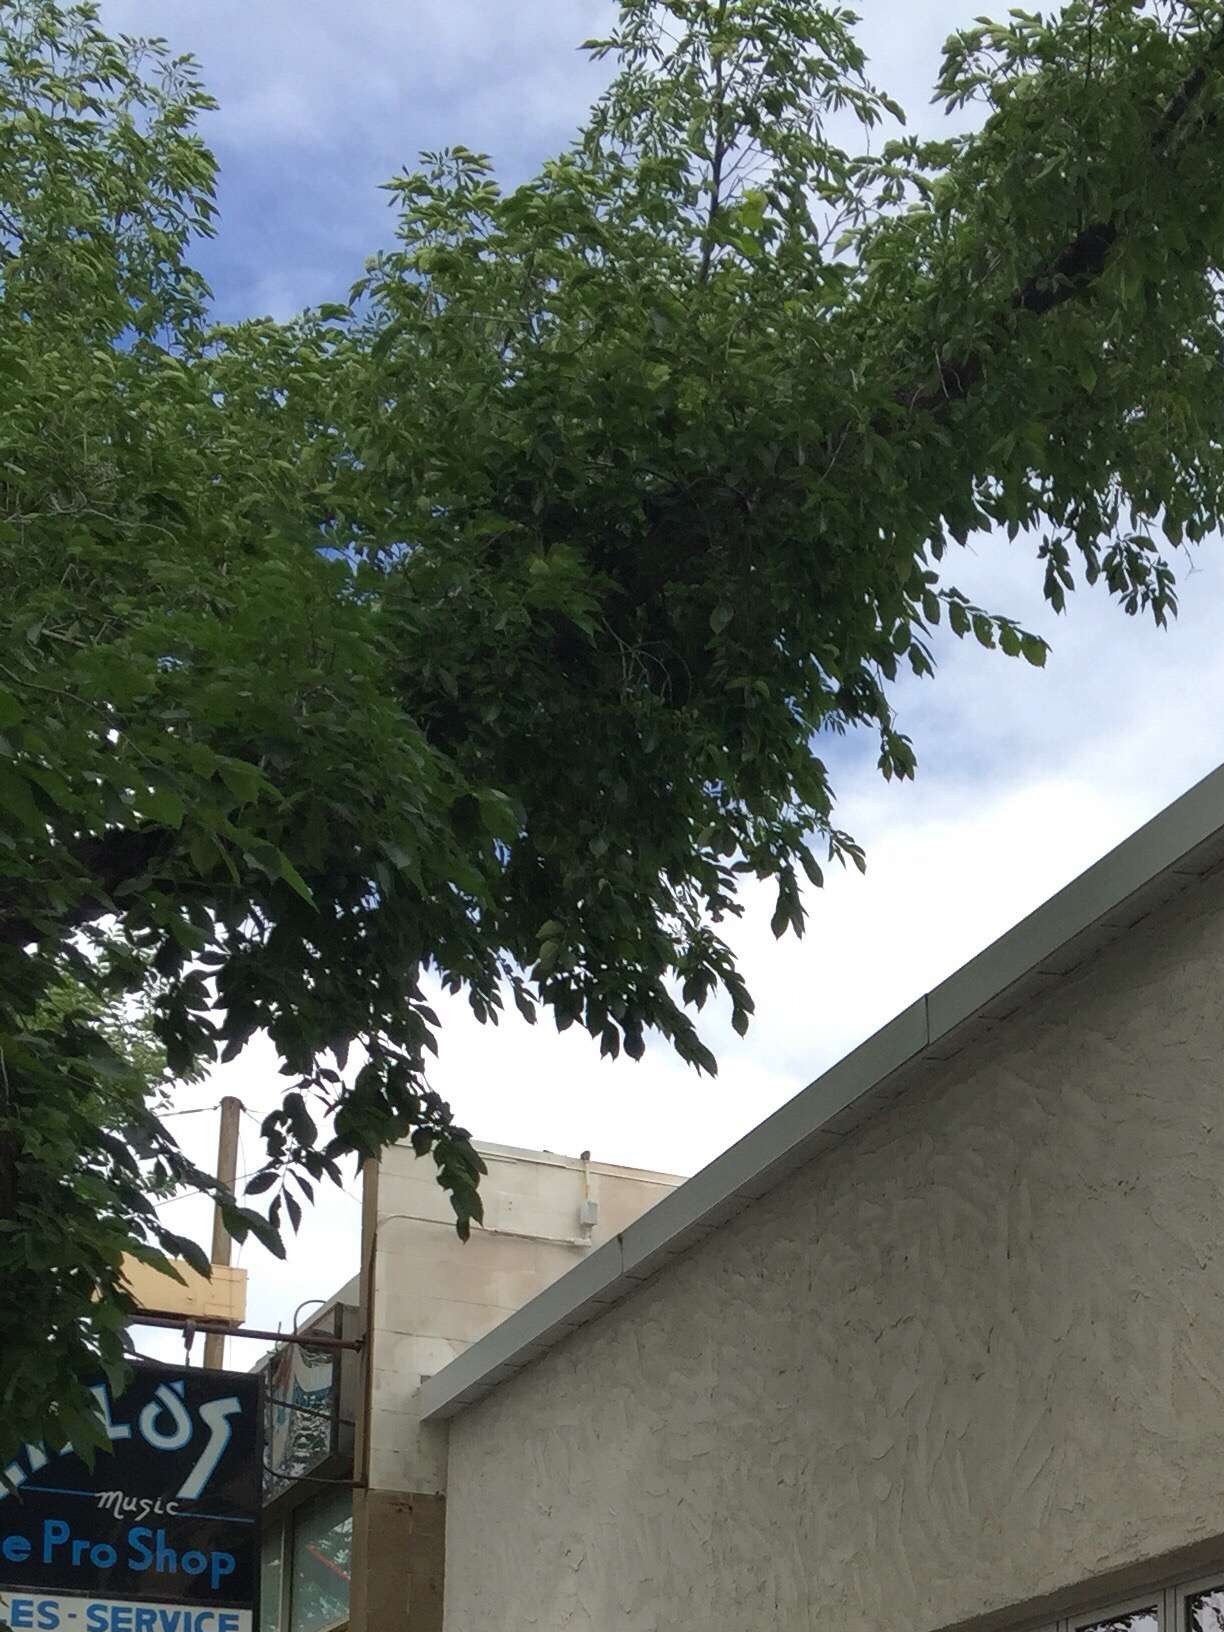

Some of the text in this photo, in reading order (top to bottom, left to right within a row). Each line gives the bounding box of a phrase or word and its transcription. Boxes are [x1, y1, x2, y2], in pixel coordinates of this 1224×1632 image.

[95, 1490, 180, 1521] Music
[43, 1519, 118, 1569] Pro
[128, 1526, 237, 1590] Shop
